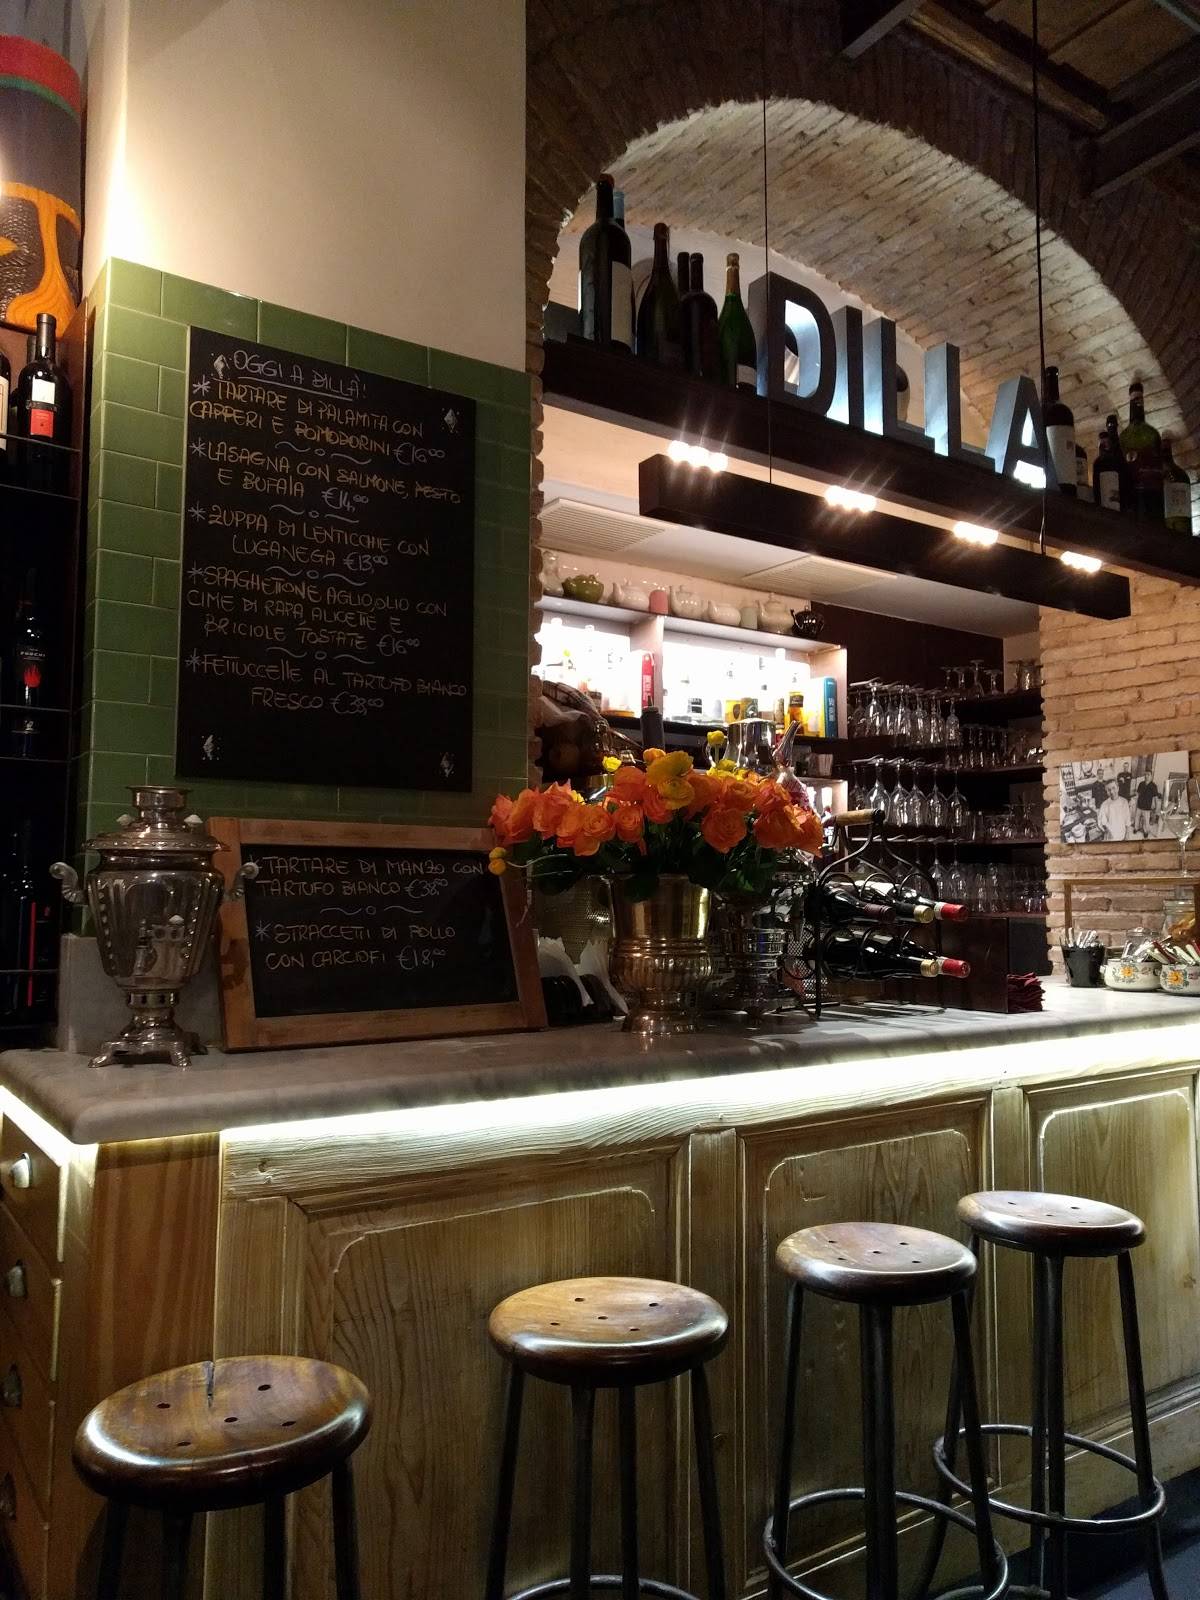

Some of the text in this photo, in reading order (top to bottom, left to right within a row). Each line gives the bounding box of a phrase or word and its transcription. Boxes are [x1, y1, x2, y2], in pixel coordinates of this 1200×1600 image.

[233, 350, 283, 378] OGGI
[290, 364, 304, 384] A
[212, 377, 423, 438] TARTARE DI PALAMITA CON
[189, 400, 263, 429] CAPPERI
[271, 415, 284, 434] E
[294, 420, 390, 456] POMODORINI
[208, 441, 289, 474] LASAGNA
[296, 462, 329, 482] CON
[415, 481, 461, 504] PESTO
[217, 467, 233, 486] E
[209, 504, 429, 556] ZUPPA DI LENTICCHIE CON
[232, 534, 336, 567] LUGANEGA
[187, 590, 234, 612] CIME
[242, 598, 258, 613] DI
[389, 616, 403, 634] E
[416, 602, 447, 616] CON
[204, 613, 286, 641] BRICIOLE
[295, 627, 368, 650] TOSTATE
[313, 668, 336, 688] AL
[342, 671, 412, 696] TARTUFO
[416, 678, 467, 696] BIANCO
[252, 687, 324, 710] FRESCO
[262, 856, 484, 876] TARTARE DI MANZO CON
[256, 880, 335, 897] TARTUFO
[341, 880, 401, 896] BIANCO
[382, 926, 397, 940] DI
[265, 952, 305, 970] CON
[311, 949, 385, 969] CARCIOFI
